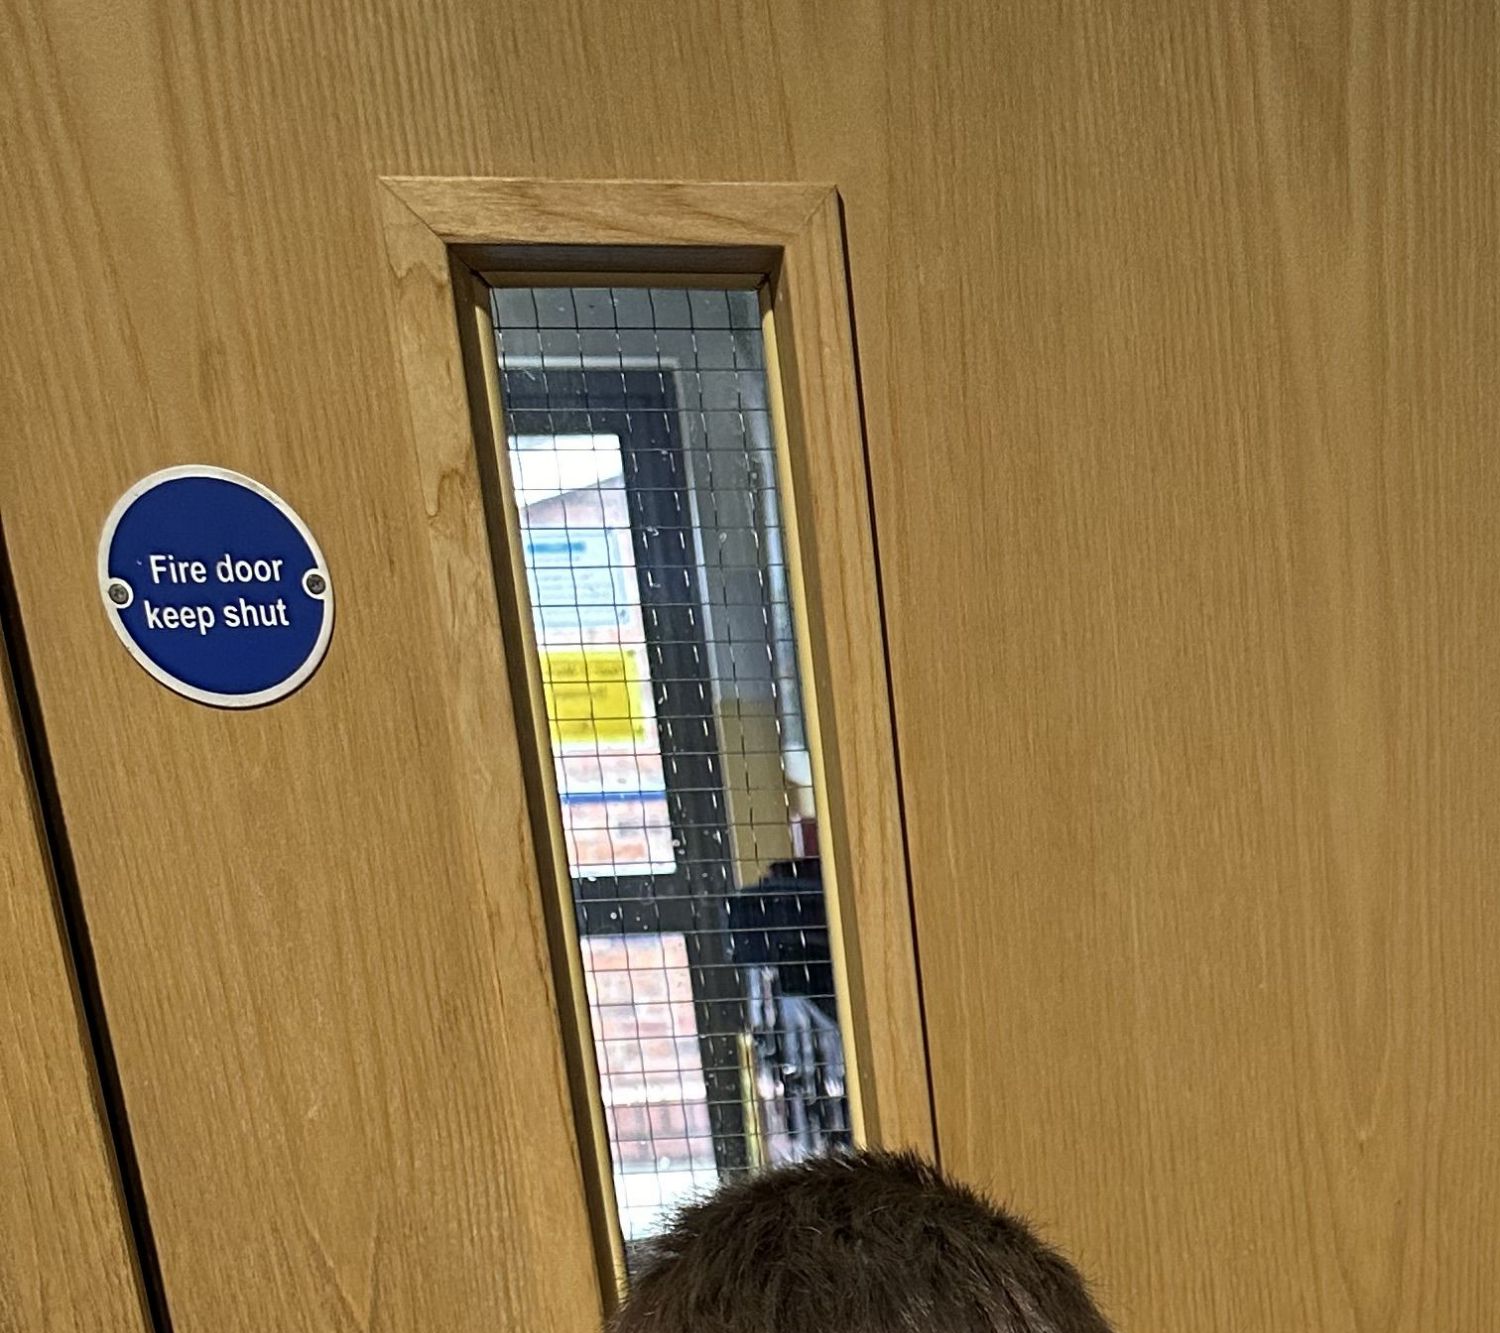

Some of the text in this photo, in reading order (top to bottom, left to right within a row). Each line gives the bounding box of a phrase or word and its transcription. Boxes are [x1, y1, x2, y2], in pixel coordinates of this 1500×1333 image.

[149, 553, 283, 584] Fire door
[144, 598, 290, 635] keep shut
